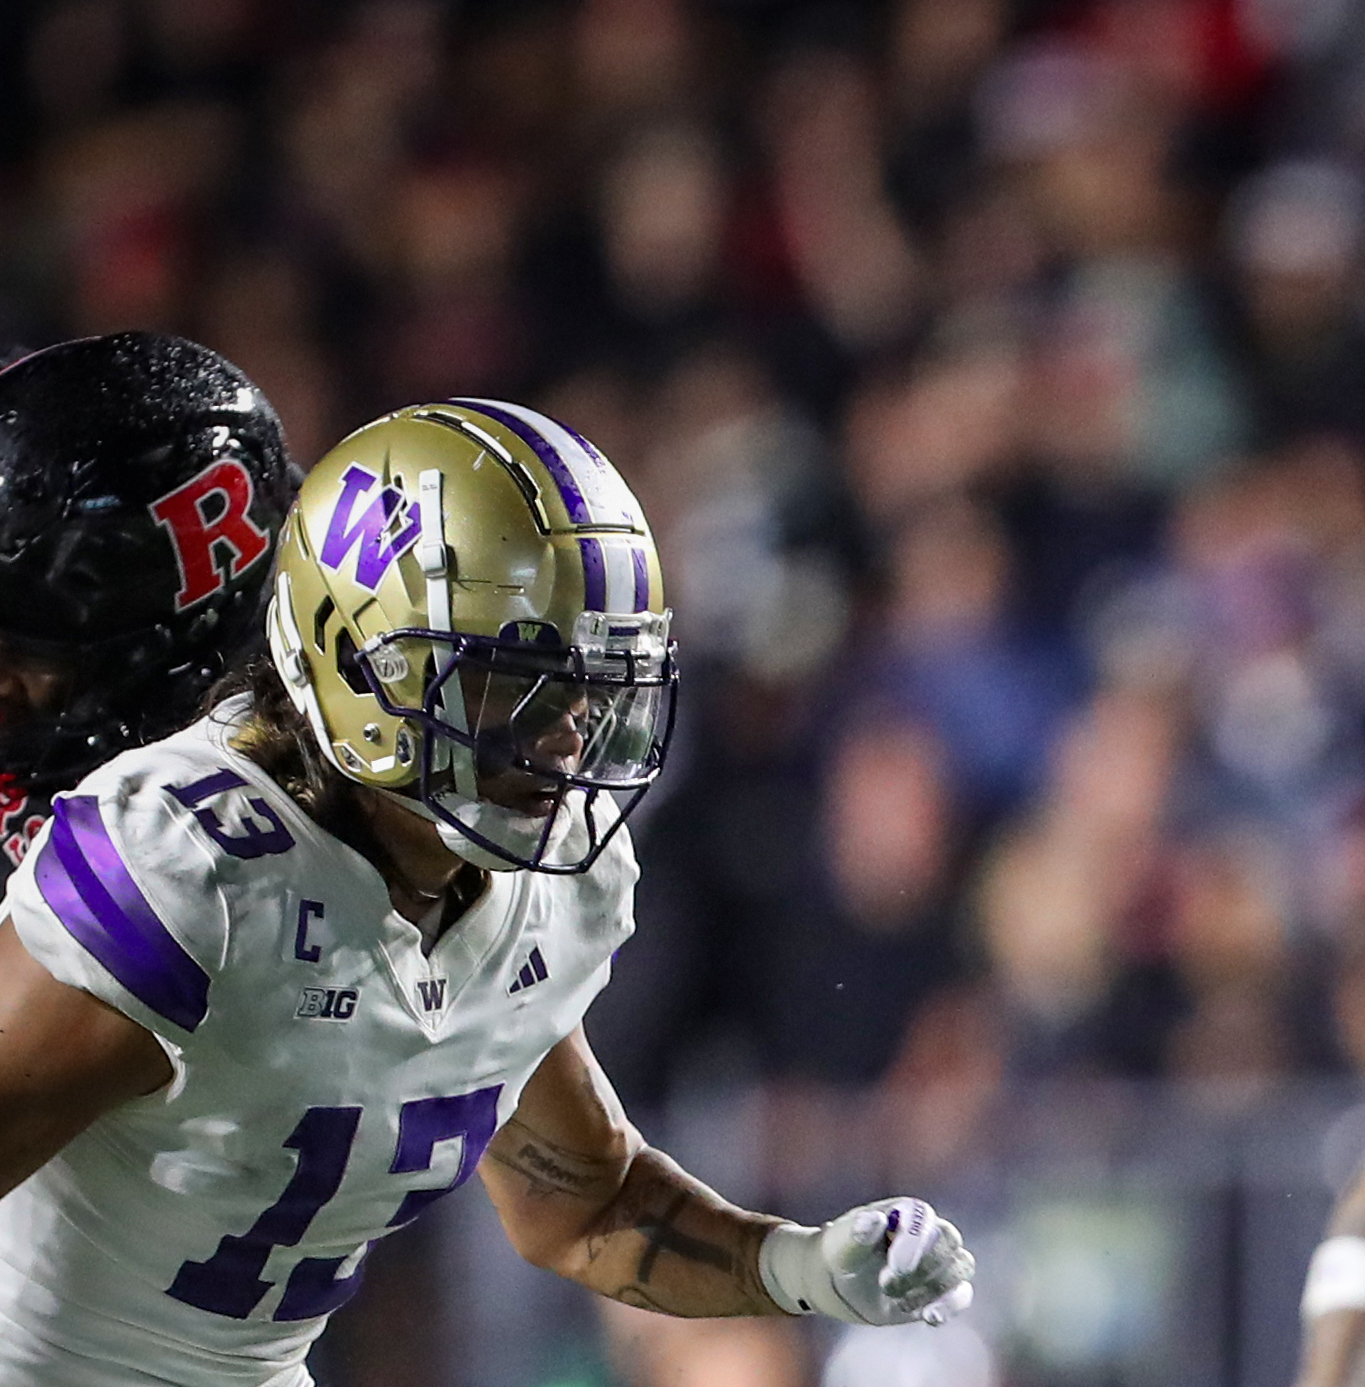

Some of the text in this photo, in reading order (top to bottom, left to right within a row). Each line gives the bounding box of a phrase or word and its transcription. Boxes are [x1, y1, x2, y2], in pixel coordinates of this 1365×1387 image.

[151, 458, 270, 612] R
[316, 461, 423, 592] W
[160, 765, 297, 861] 13
[294, 899, 325, 964] C
[297, 986, 361, 1021] BIG
[416, 978, 447, 1012] W
